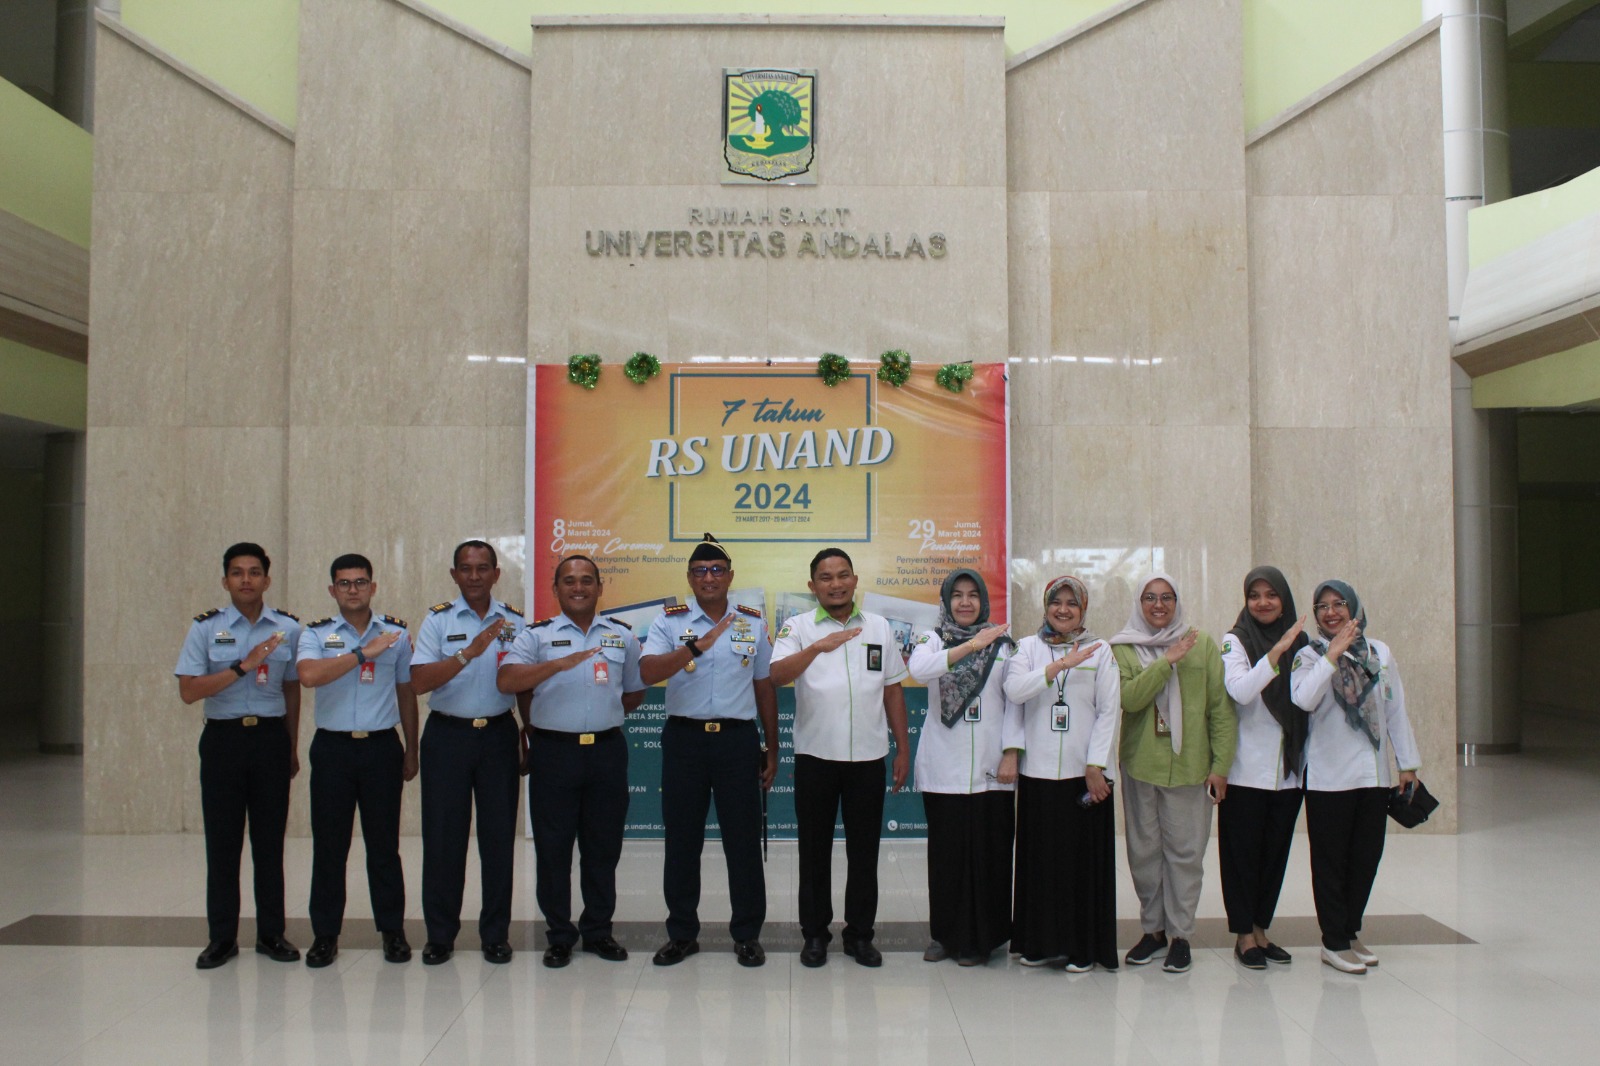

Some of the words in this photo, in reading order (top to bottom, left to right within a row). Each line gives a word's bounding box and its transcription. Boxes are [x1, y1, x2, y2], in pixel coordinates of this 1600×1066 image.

[689, 206, 772, 226] RUMAH
[779, 206, 850, 227] SAKIT
[585, 230, 787, 258] UNIVERSITAS
[797, 231, 948, 259] ANDALAS
[721, 399, 746, 427] 7
[752, 397, 825, 423] tahun
[645, 436, 709, 478] RS
[721, 426, 894, 473] UNAND
[734, 482, 812, 510] 2024
[552, 518, 566, 538] 8
[567, 529, 590, 537] Maret
[591, 529, 612, 537] 2024
[908, 519, 936, 539] 29
[938, 530, 960, 538] Maret
[962, 530, 981, 538] 2024
[550, 537, 599, 555] Opening
[602, 537, 665, 555] Ceremony
[642, 554, 687, 563] Ramadhan
[896, 555, 945, 566] Penyerahan
[897, 567, 927, 575] Tausiah
[876, 578, 900, 586] BUKA
[902, 578, 930, 586] PUASA
[628, 726, 663, 734] OPENING
